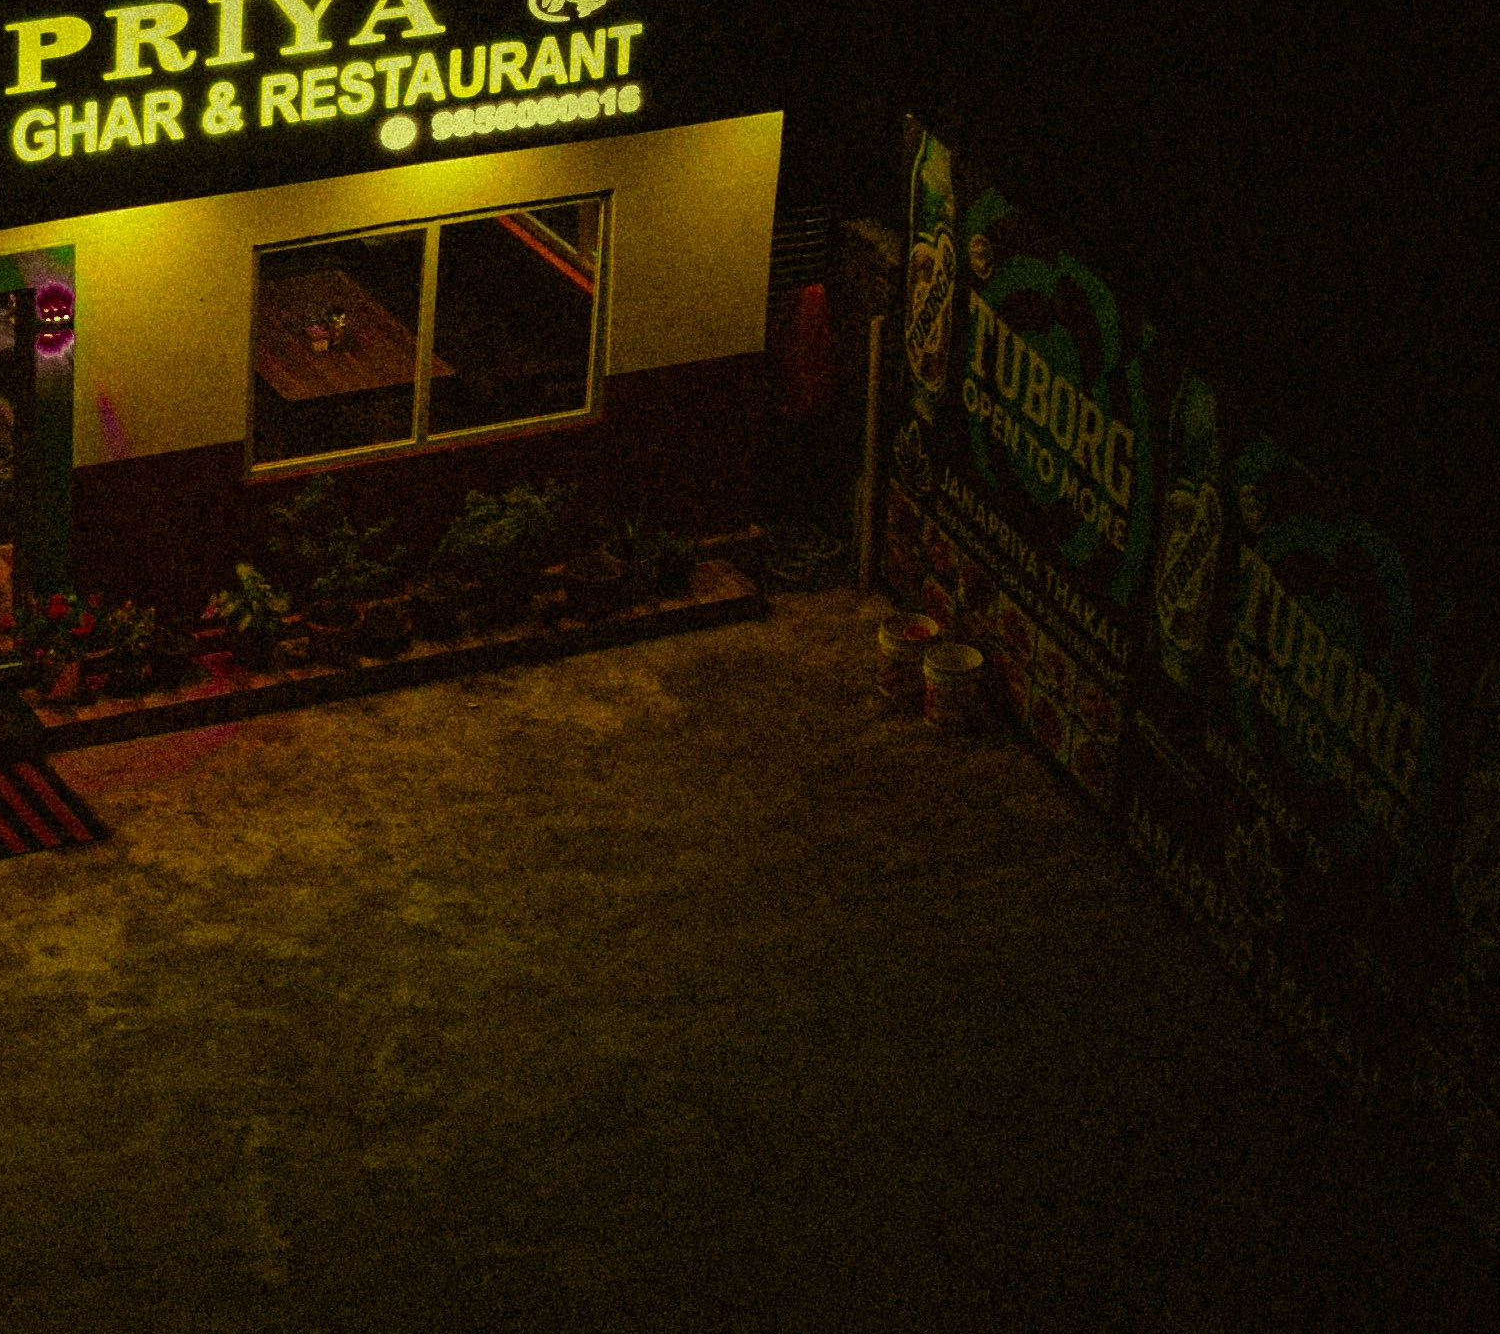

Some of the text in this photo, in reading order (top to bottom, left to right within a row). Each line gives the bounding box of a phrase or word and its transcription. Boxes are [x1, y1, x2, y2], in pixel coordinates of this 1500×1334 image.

[11, 88, 186, 163] GHAR
[200, 80, 246, 136] &
[259, 22, 644, 128] RESTAURANT
[961, 376, 1022, 453] OPEN
[1024, 429, 1056, 485] TO
[966, 287, 1136, 510] TUBORG
[1238, 543, 1423, 799] TUBORG
